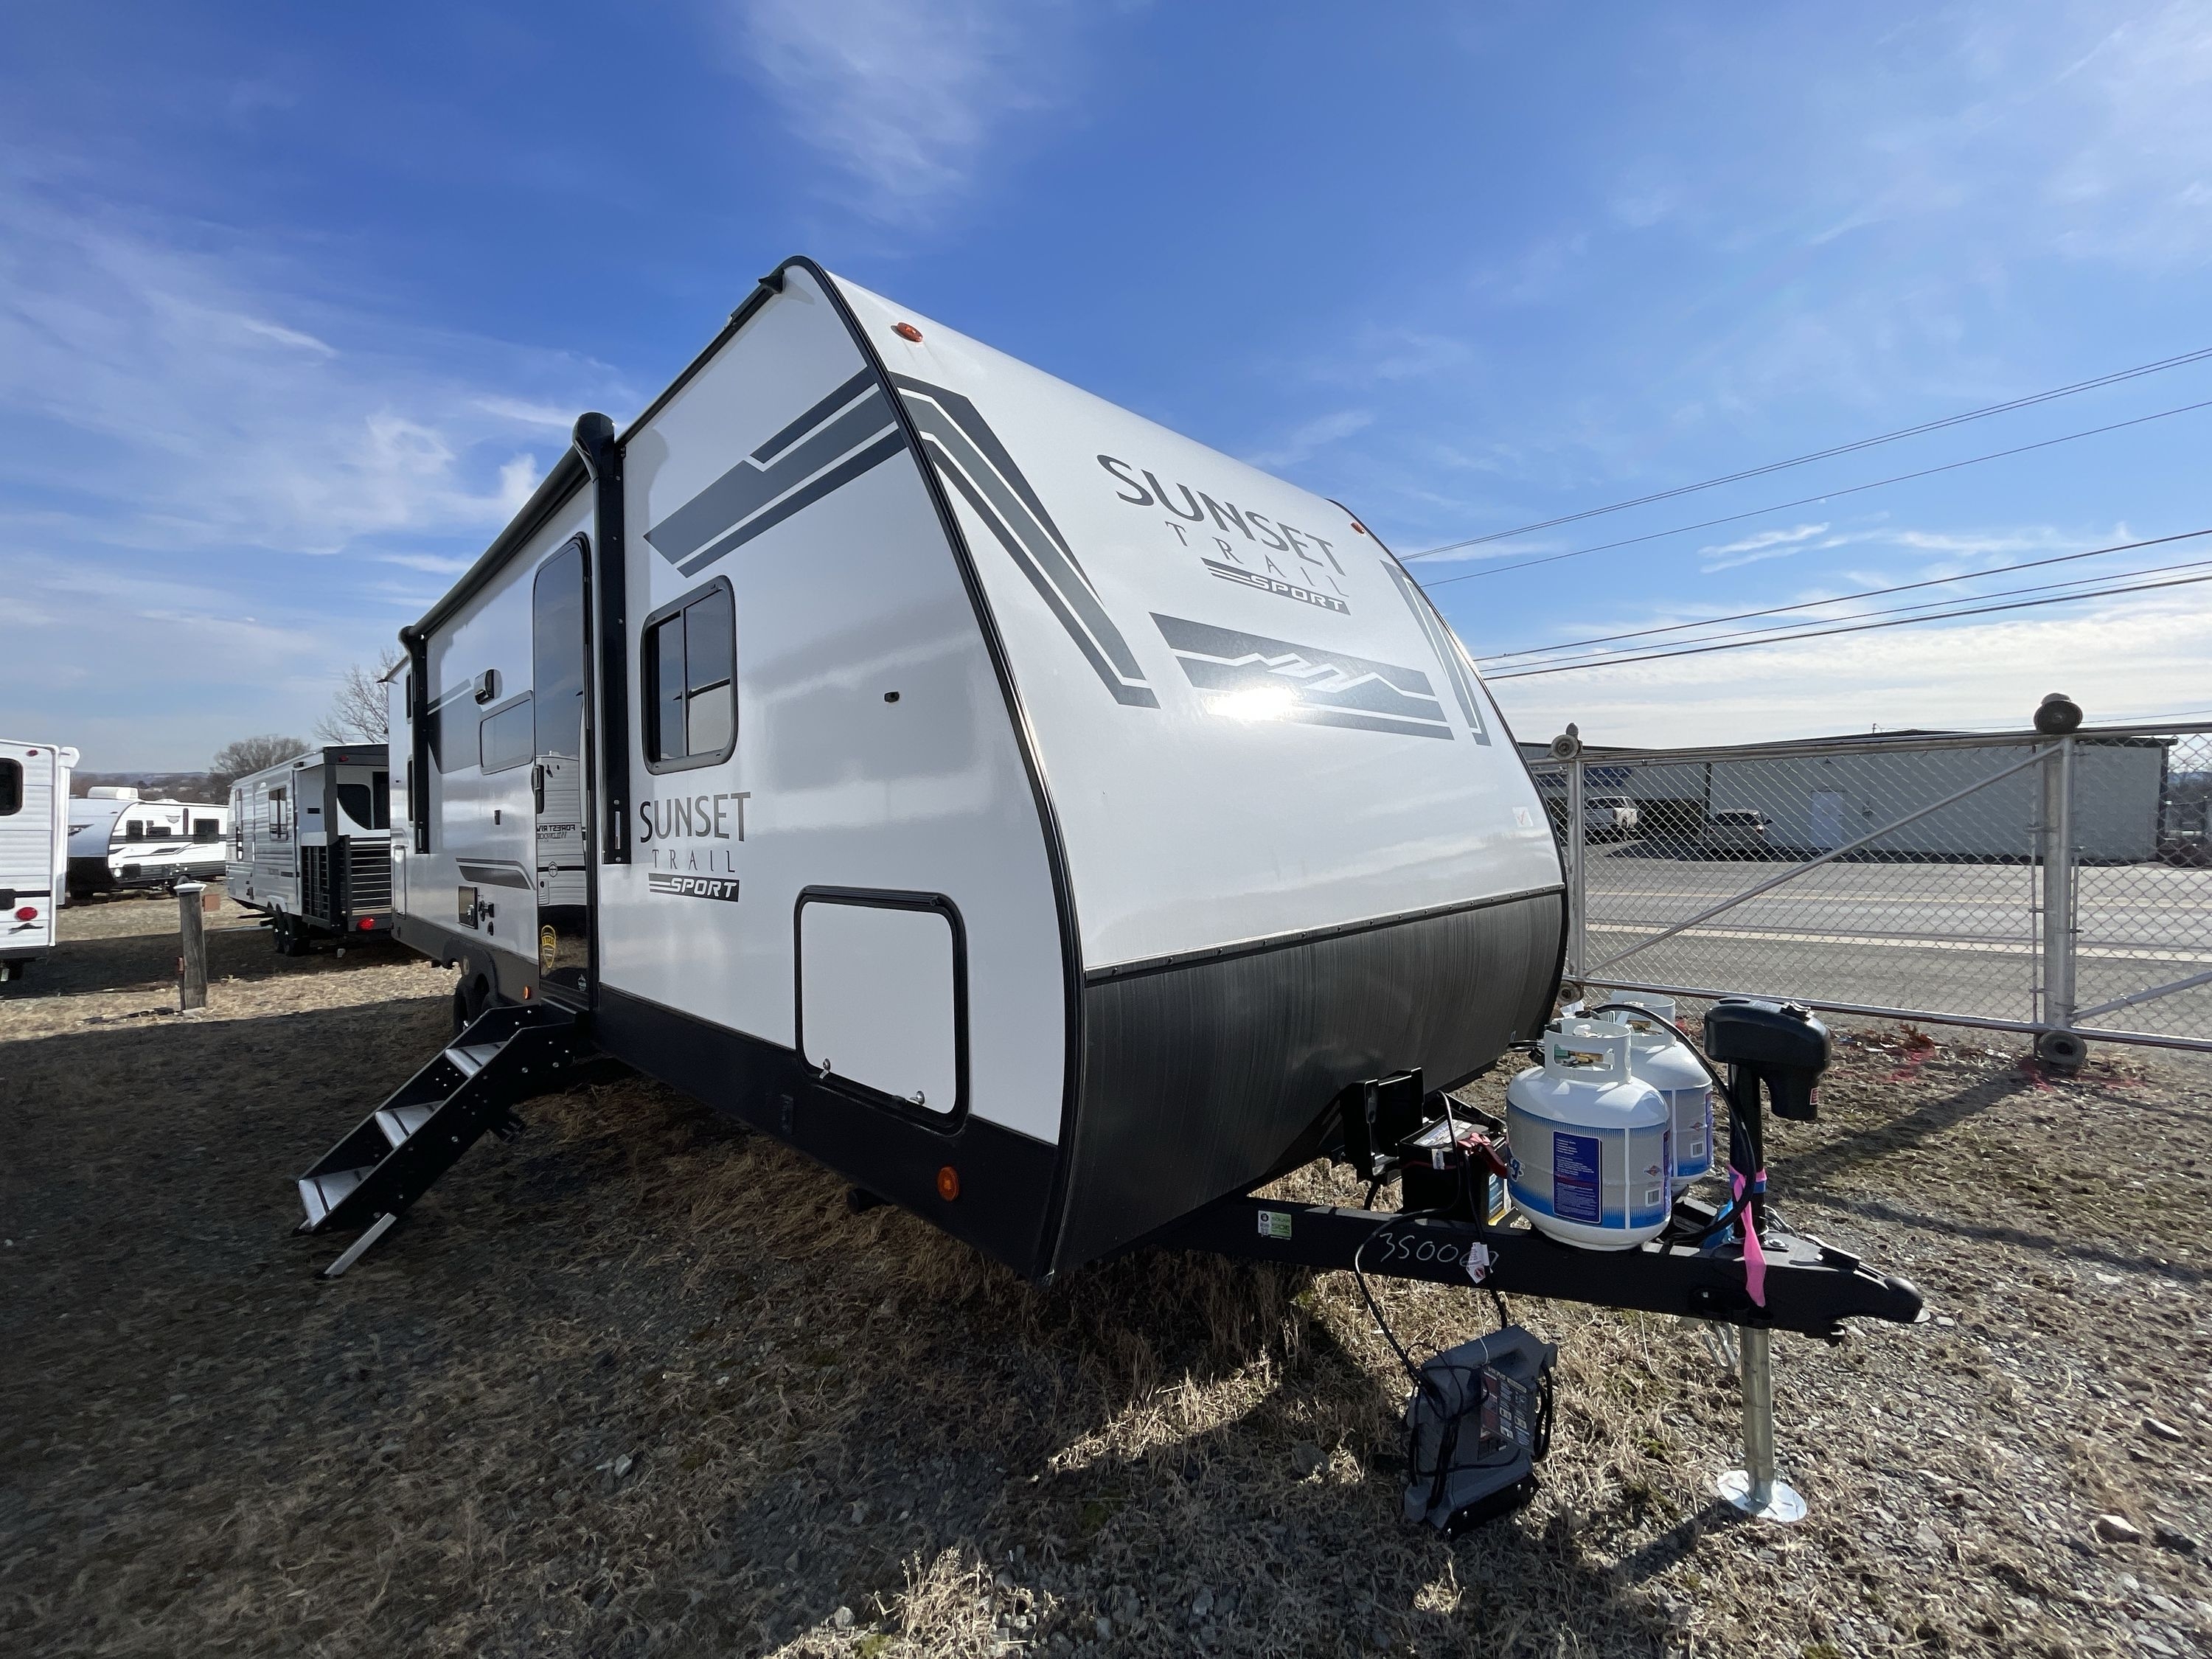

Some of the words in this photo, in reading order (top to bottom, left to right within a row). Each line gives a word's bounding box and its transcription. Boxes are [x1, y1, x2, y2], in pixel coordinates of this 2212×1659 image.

[1096, 453, 1346, 577] SUNSET
[1164, 521, 1349, 597] TRAIL
[1248, 574, 1343, 611] SPORT
[639, 791, 751, 843] SUNSET
[652, 849, 735, 873] TRAIL
[670, 877, 737, 898] SPORT
